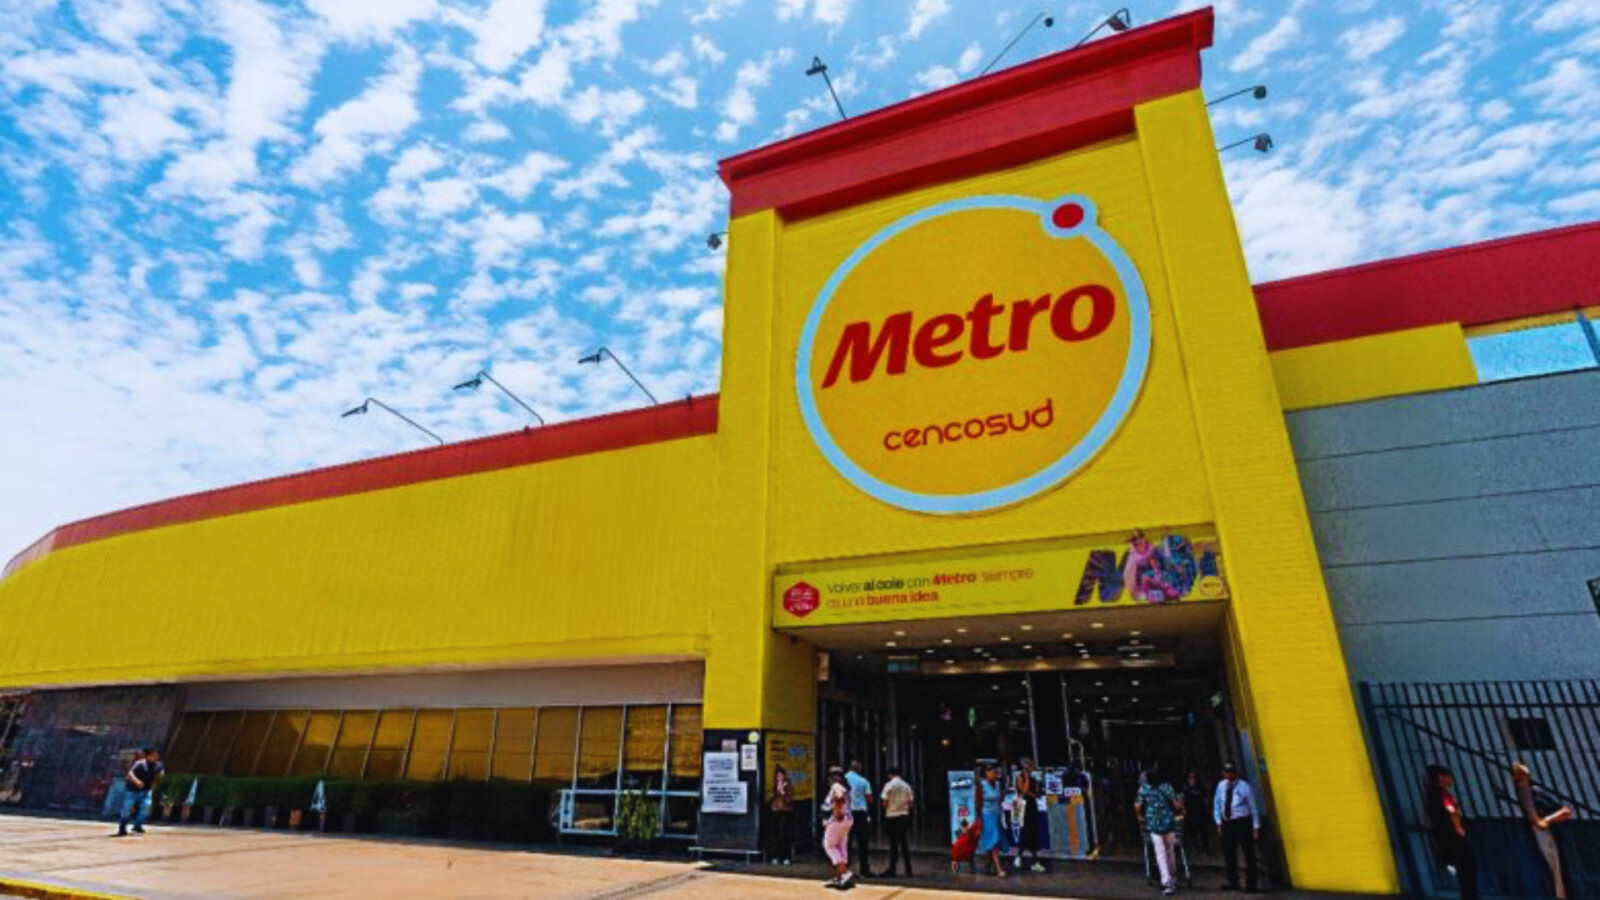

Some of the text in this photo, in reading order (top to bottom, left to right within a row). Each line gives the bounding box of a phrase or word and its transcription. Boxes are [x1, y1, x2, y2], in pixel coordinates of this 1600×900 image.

[820, 284, 1116, 390] Metro
[883, 398, 1054, 451] cencosud
[863, 578, 875, 591] al
[906, 575, 930, 588] con
[932, 572, 977, 586] Metro
[866, 593, 908, 606] buena
[910, 590, 939, 603] idea
